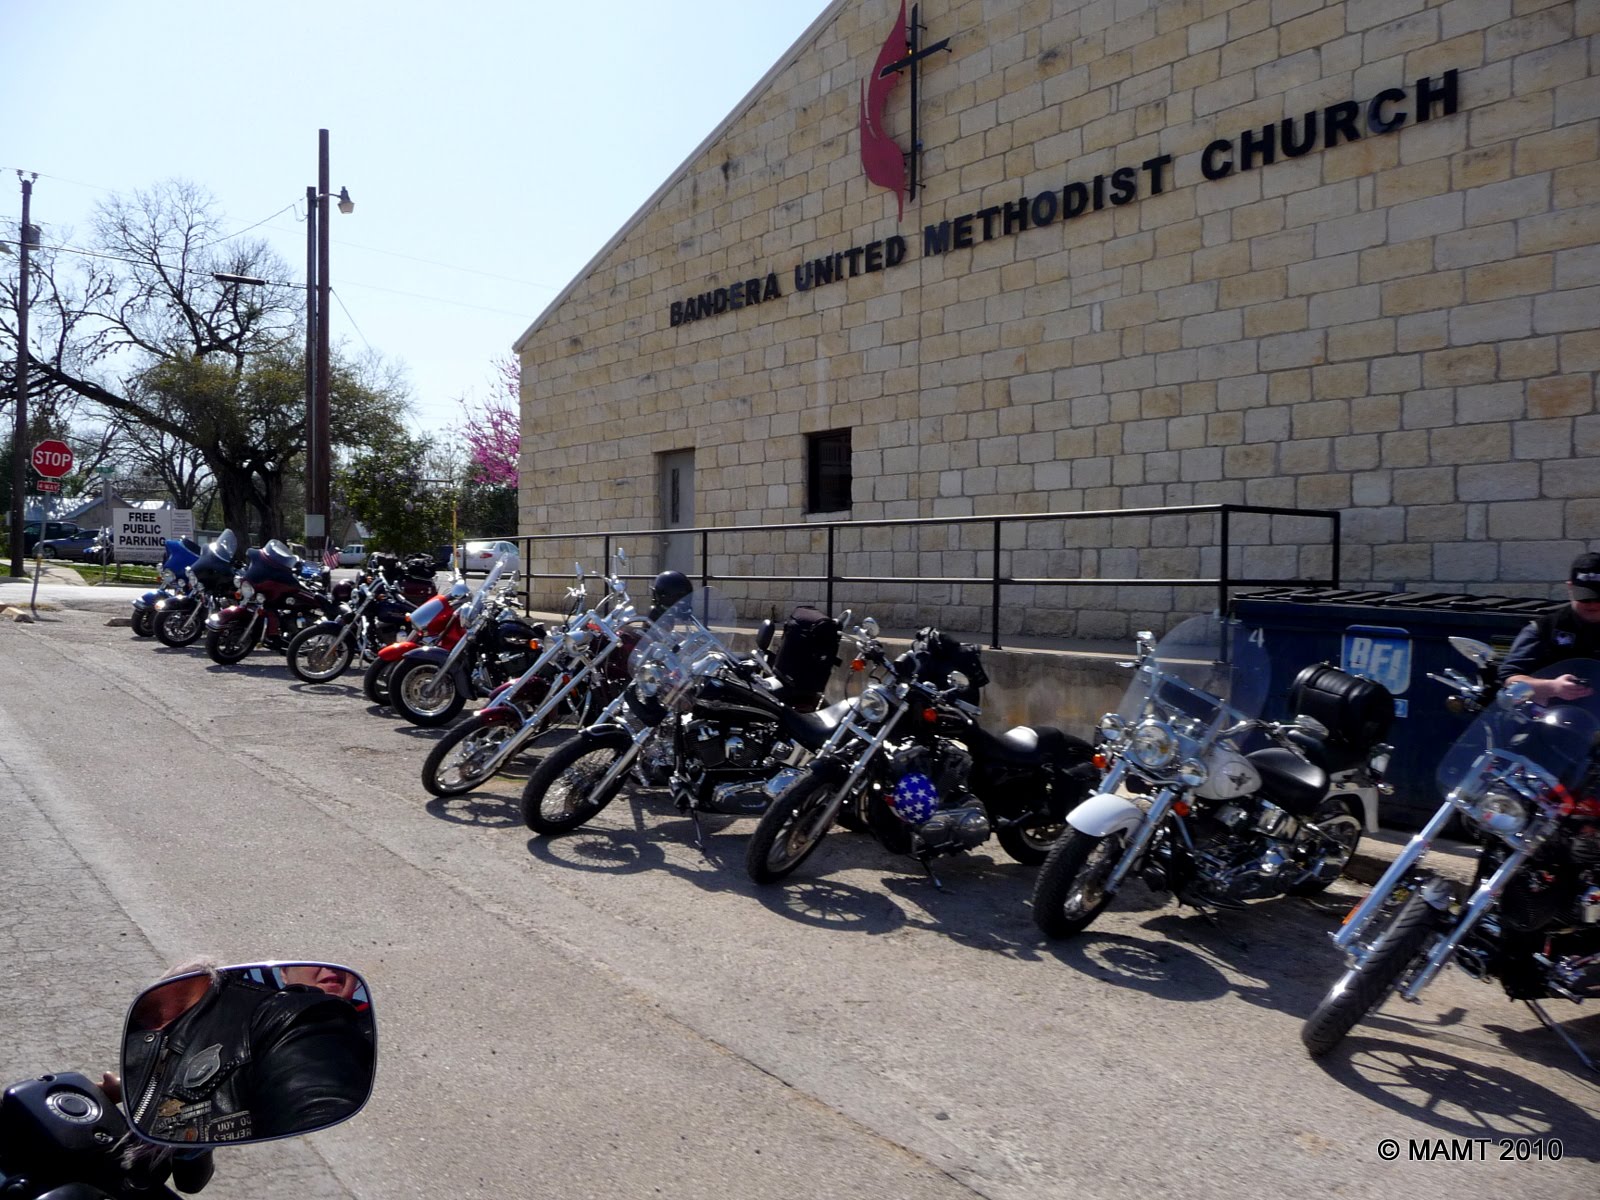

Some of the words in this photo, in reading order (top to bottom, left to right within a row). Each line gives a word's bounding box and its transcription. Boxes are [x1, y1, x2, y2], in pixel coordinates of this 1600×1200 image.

[670, 272, 782, 327] BANDERA
[794, 235, 906, 291] UNITED
[923, 155, 1171, 257] METHODIST
[1201, 68, 1458, 181] CHURCH
[34, 450, 71, 467] STOP
[128, 512, 156, 522] FREE
[123, 524, 161, 534] PUBLIC
[119, 536, 166, 546] PARKING
[1248, 627, 1265, 648] 4
[1349, 637, 1405, 680] BFI
